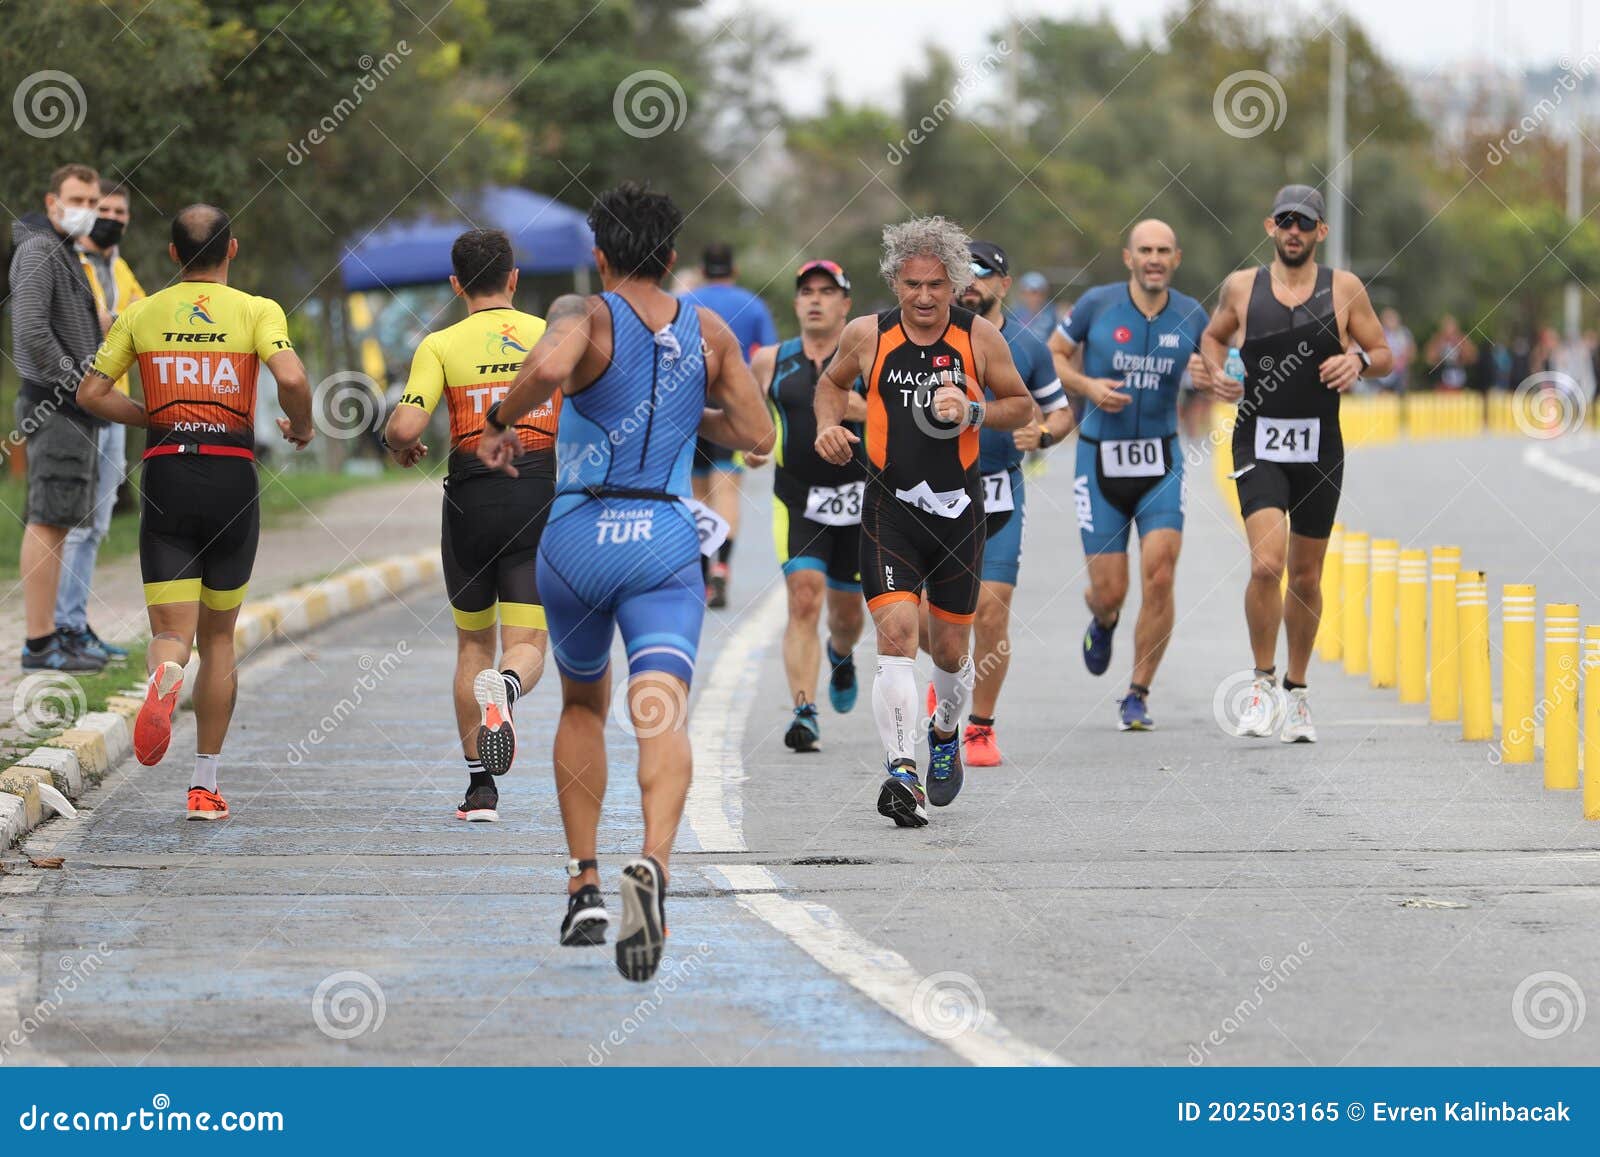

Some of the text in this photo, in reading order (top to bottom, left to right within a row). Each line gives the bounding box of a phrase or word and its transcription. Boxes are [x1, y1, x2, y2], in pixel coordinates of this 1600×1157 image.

[162, 332, 230, 343] TREK
[476, 362, 524, 374] TRE
[212, 384, 240, 394] TEAM
[1125, 371, 1161, 391] TUR
[900, 389, 938, 408] TU
[174, 421, 226, 433] KAPTAN
[1264, 427, 1312, 451] 241
[1112, 442, 1157, 467] 160
[596, 520, 653, 545] TUR
[885, 565, 896, 591] 2XU
